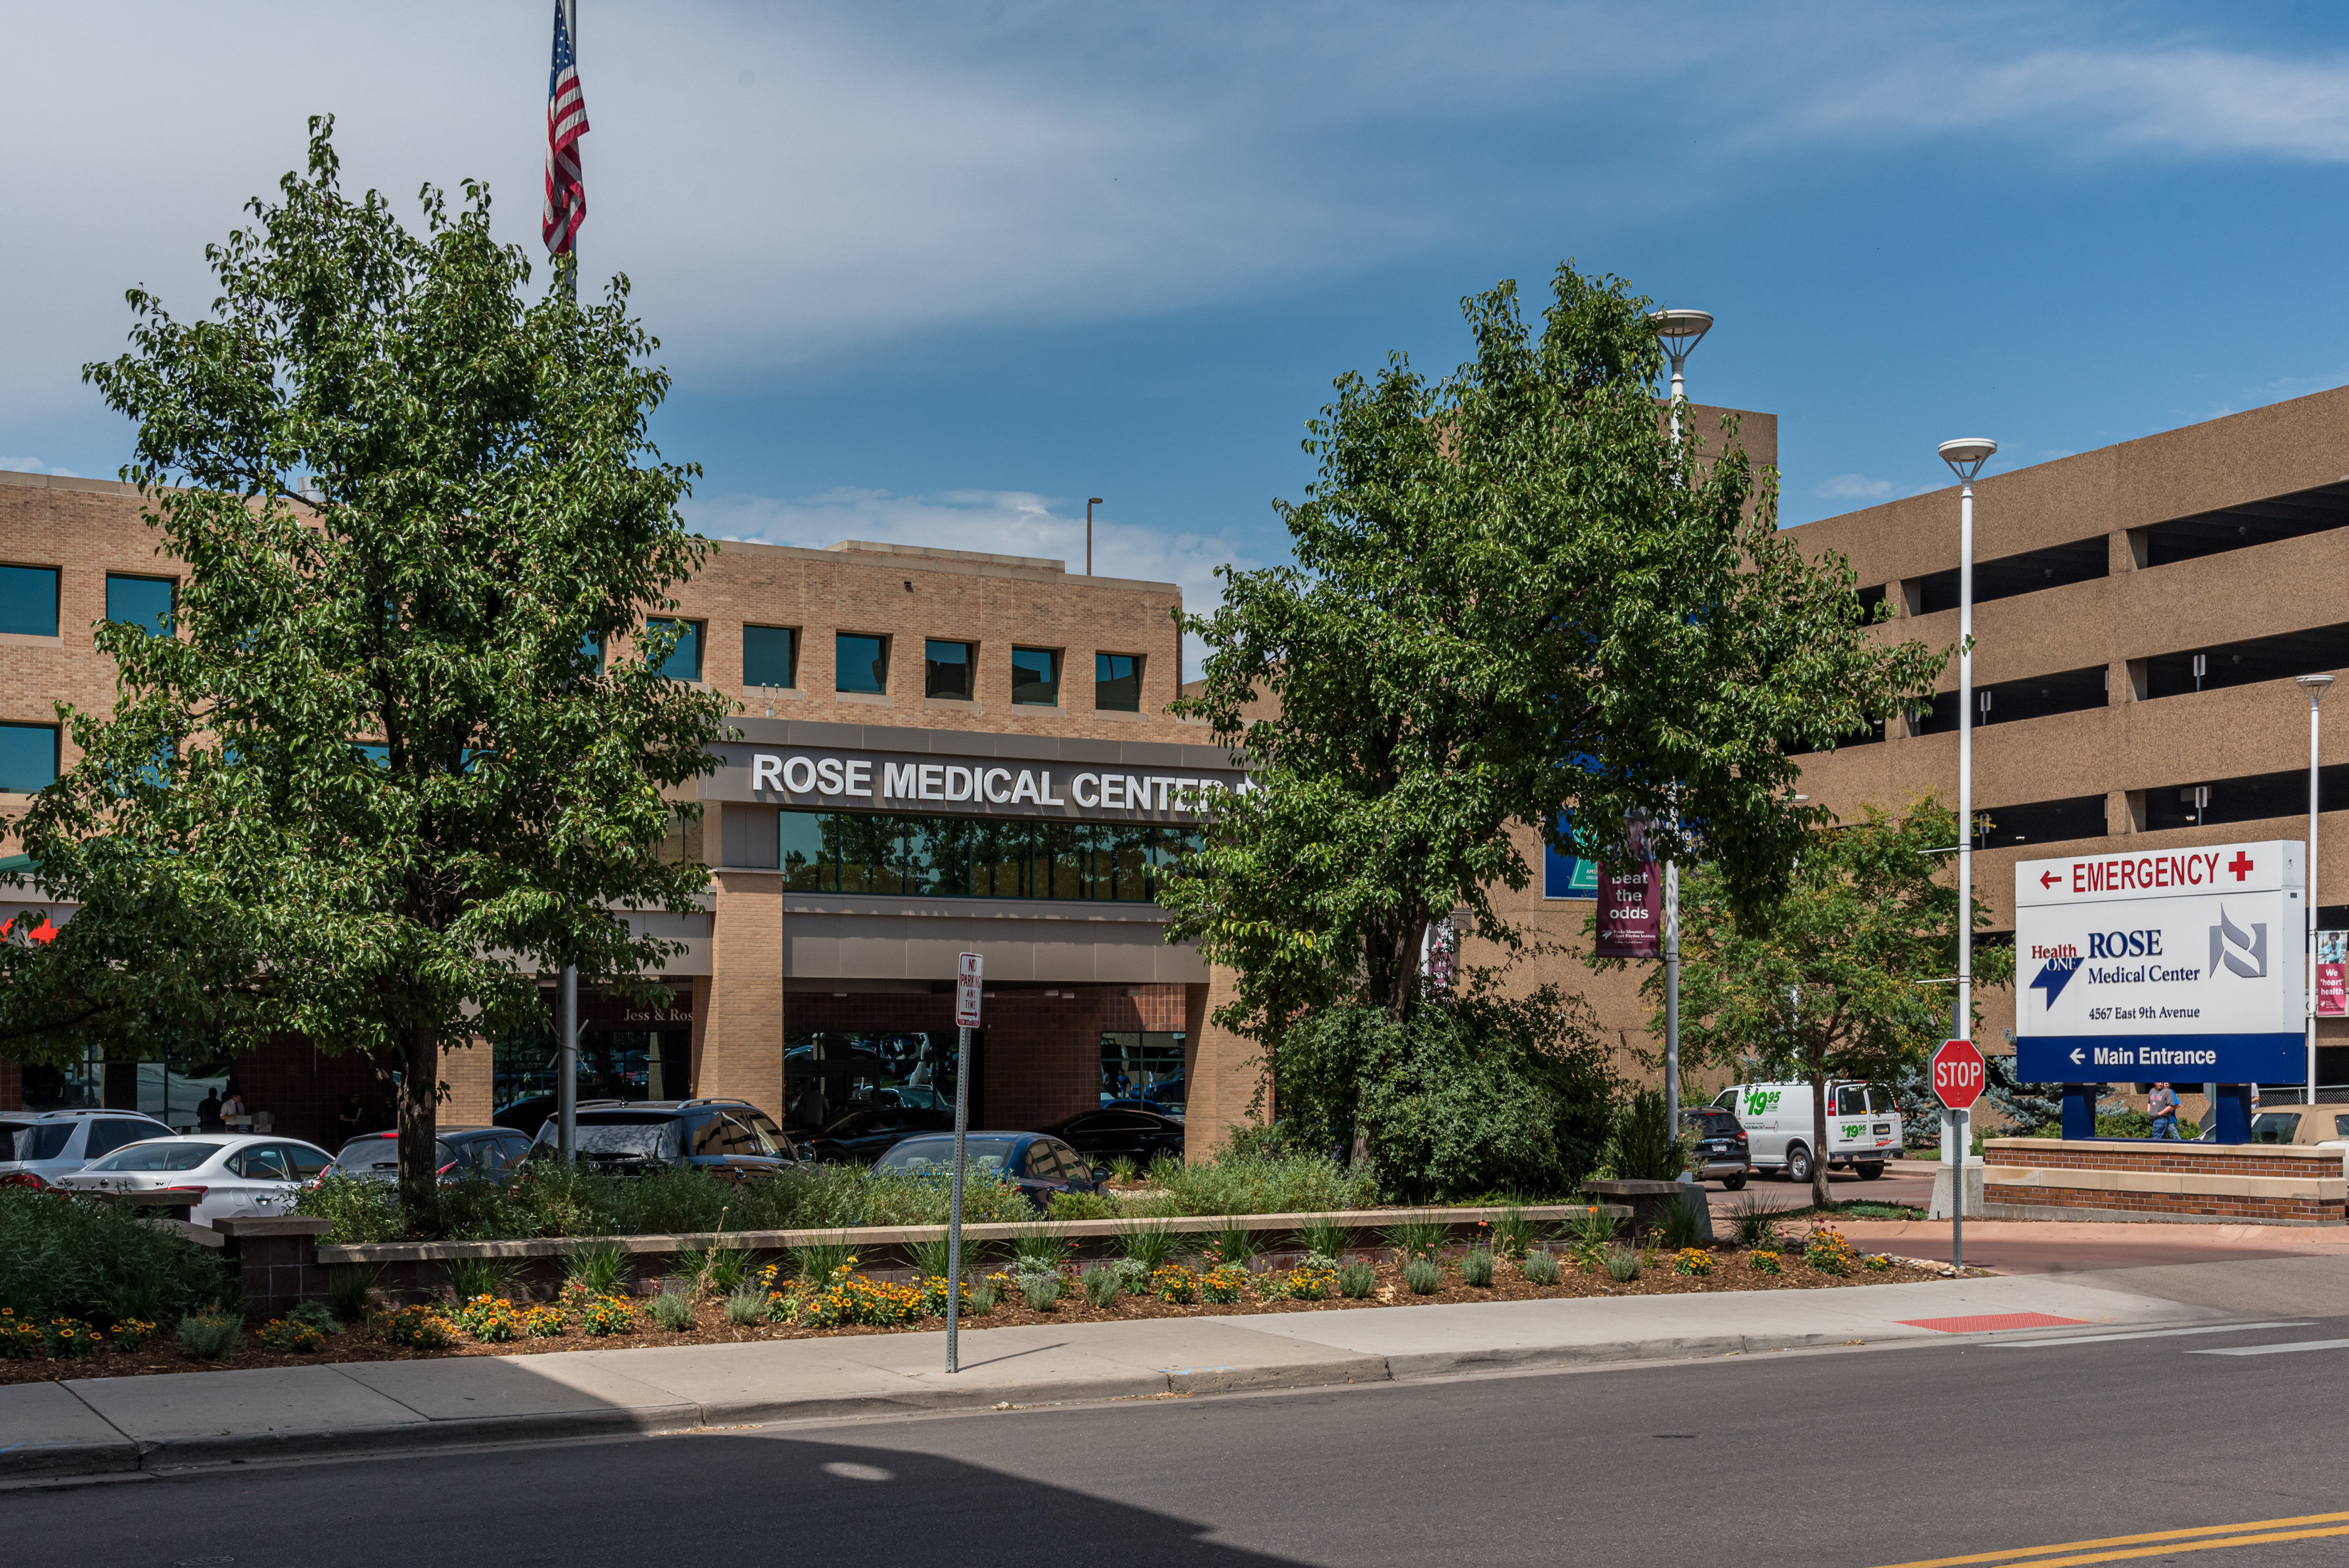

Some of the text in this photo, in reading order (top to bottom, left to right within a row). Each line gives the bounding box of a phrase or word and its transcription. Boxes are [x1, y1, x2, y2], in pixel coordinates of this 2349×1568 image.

[752, 754, 873, 796] ROSE
[883, 762, 1065, 806] MEDICAL
[2073, 853, 2220, 893] EMERGENCY
[1616, 889, 1642, 902] the
[1609, 906, 1649, 920] odds
[2032, 944, 2078, 959] Health
[2088, 930, 2163, 959] ROSE
[969, 959, 977, 972] NO
[2046, 957, 2078, 972] ONE
[961, 974, 981, 989] PARKING
[2088, 964, 2200, 984] Medical Center
[967, 989, 976, 999] ANY
[965, 999, 976, 1009] TIME
[624, 1008, 650, 1021] Jess
[654, 1008, 666, 1021] &
[2088, 1006, 2200, 1020] 4567 East 9th Avenue
[2093, 1046, 2217, 1065] Main Entrance
[1937, 1061, 1982, 1088] STOP
